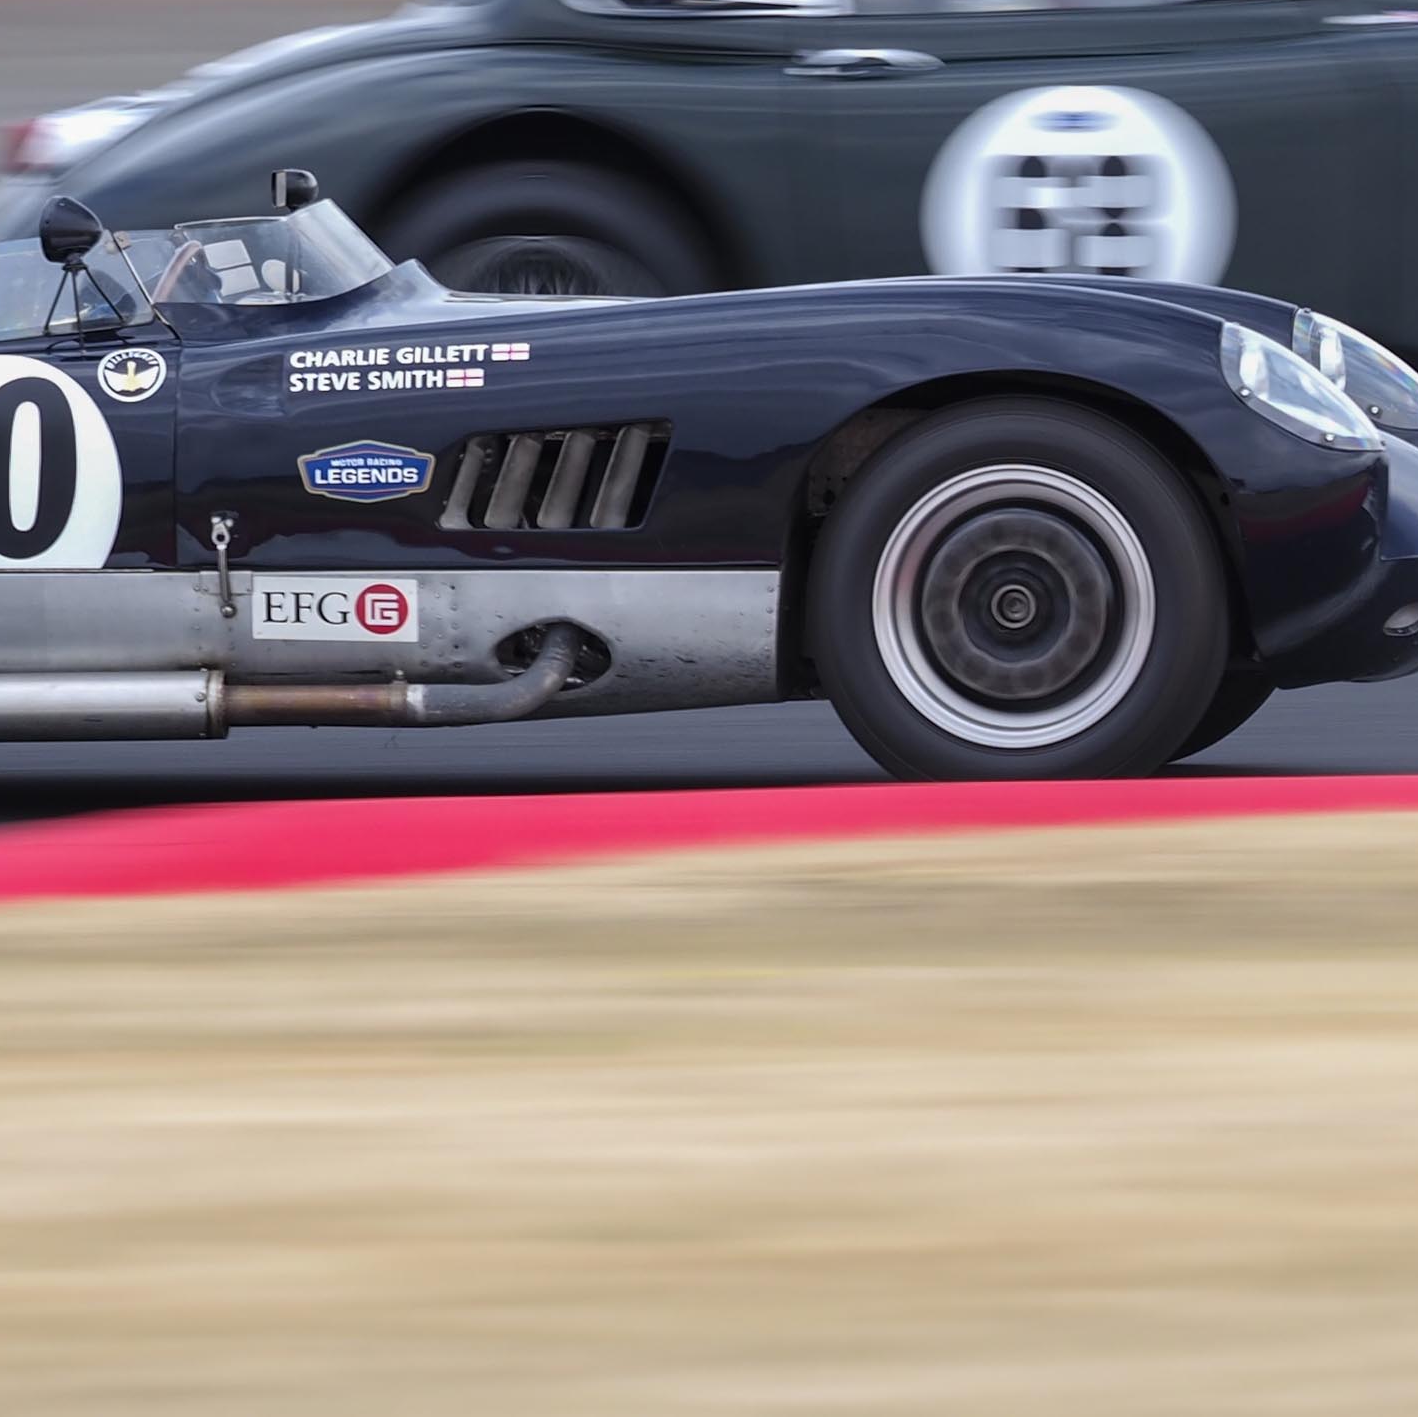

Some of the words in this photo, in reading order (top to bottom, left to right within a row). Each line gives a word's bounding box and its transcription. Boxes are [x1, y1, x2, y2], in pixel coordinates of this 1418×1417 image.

[290, 348, 390, 368] CHARLIE
[396, 344, 489, 364] GILLETT
[289, 372, 361, 392] STEVE
[368, 369, 444, 390] SMITH
[330, 458, 364, 467] MOTOR
[367, 458, 403, 467] RACING
[314, 468, 419, 484] LEGENDS
[262, 592, 351, 625] EFG
